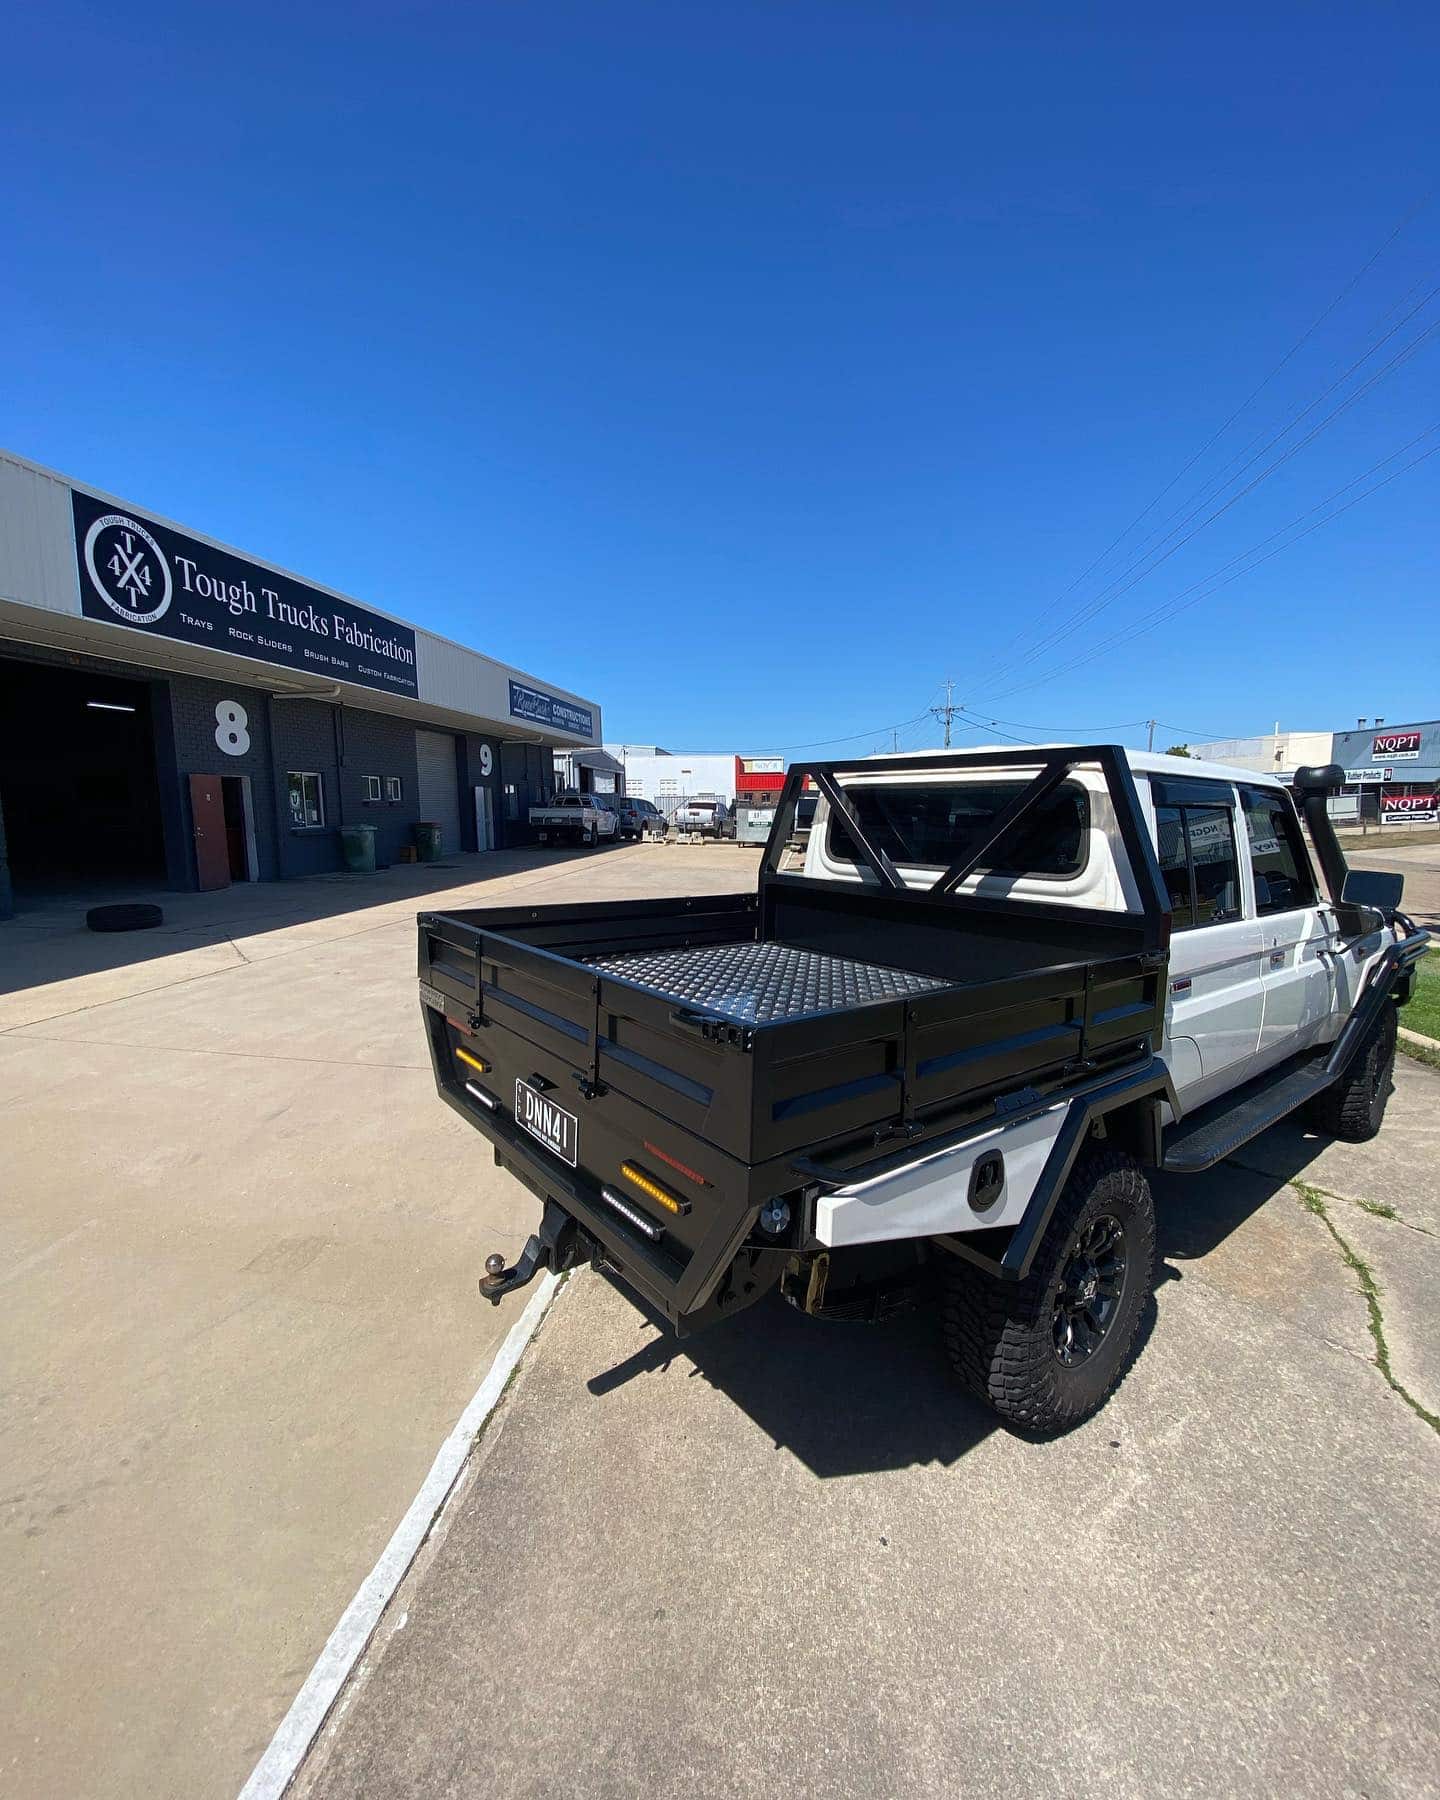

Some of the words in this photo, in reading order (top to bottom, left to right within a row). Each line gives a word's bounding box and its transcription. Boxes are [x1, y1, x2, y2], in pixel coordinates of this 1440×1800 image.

[100, 517, 124, 527] TOUGH
[120, 531, 136, 554] T
[125, 585, 141, 608] T
[110, 602, 157, 623] FABRICATION
[175, 555, 257, 615] Tough
[261, 587, 329, 636] Trucks
[333, 614, 414, 665] Fabrication
[179, 612, 213, 631] TRAYS
[229, 627, 254, 642] ROCK
[257, 635, 292, 652] SLIDERS
[304, 649, 329, 664] BRUSH
[331, 656, 349, 669] BARS
[358, 664, 382, 677] CUSTOM
[383, 672, 415, 687] FABRICATION
[215, 700, 250, 756] 8
[1375, 736, 1417, 752] NQPT
[479, 743, 493, 777] 9
[1385, 798, 1434, 811] NQPT
